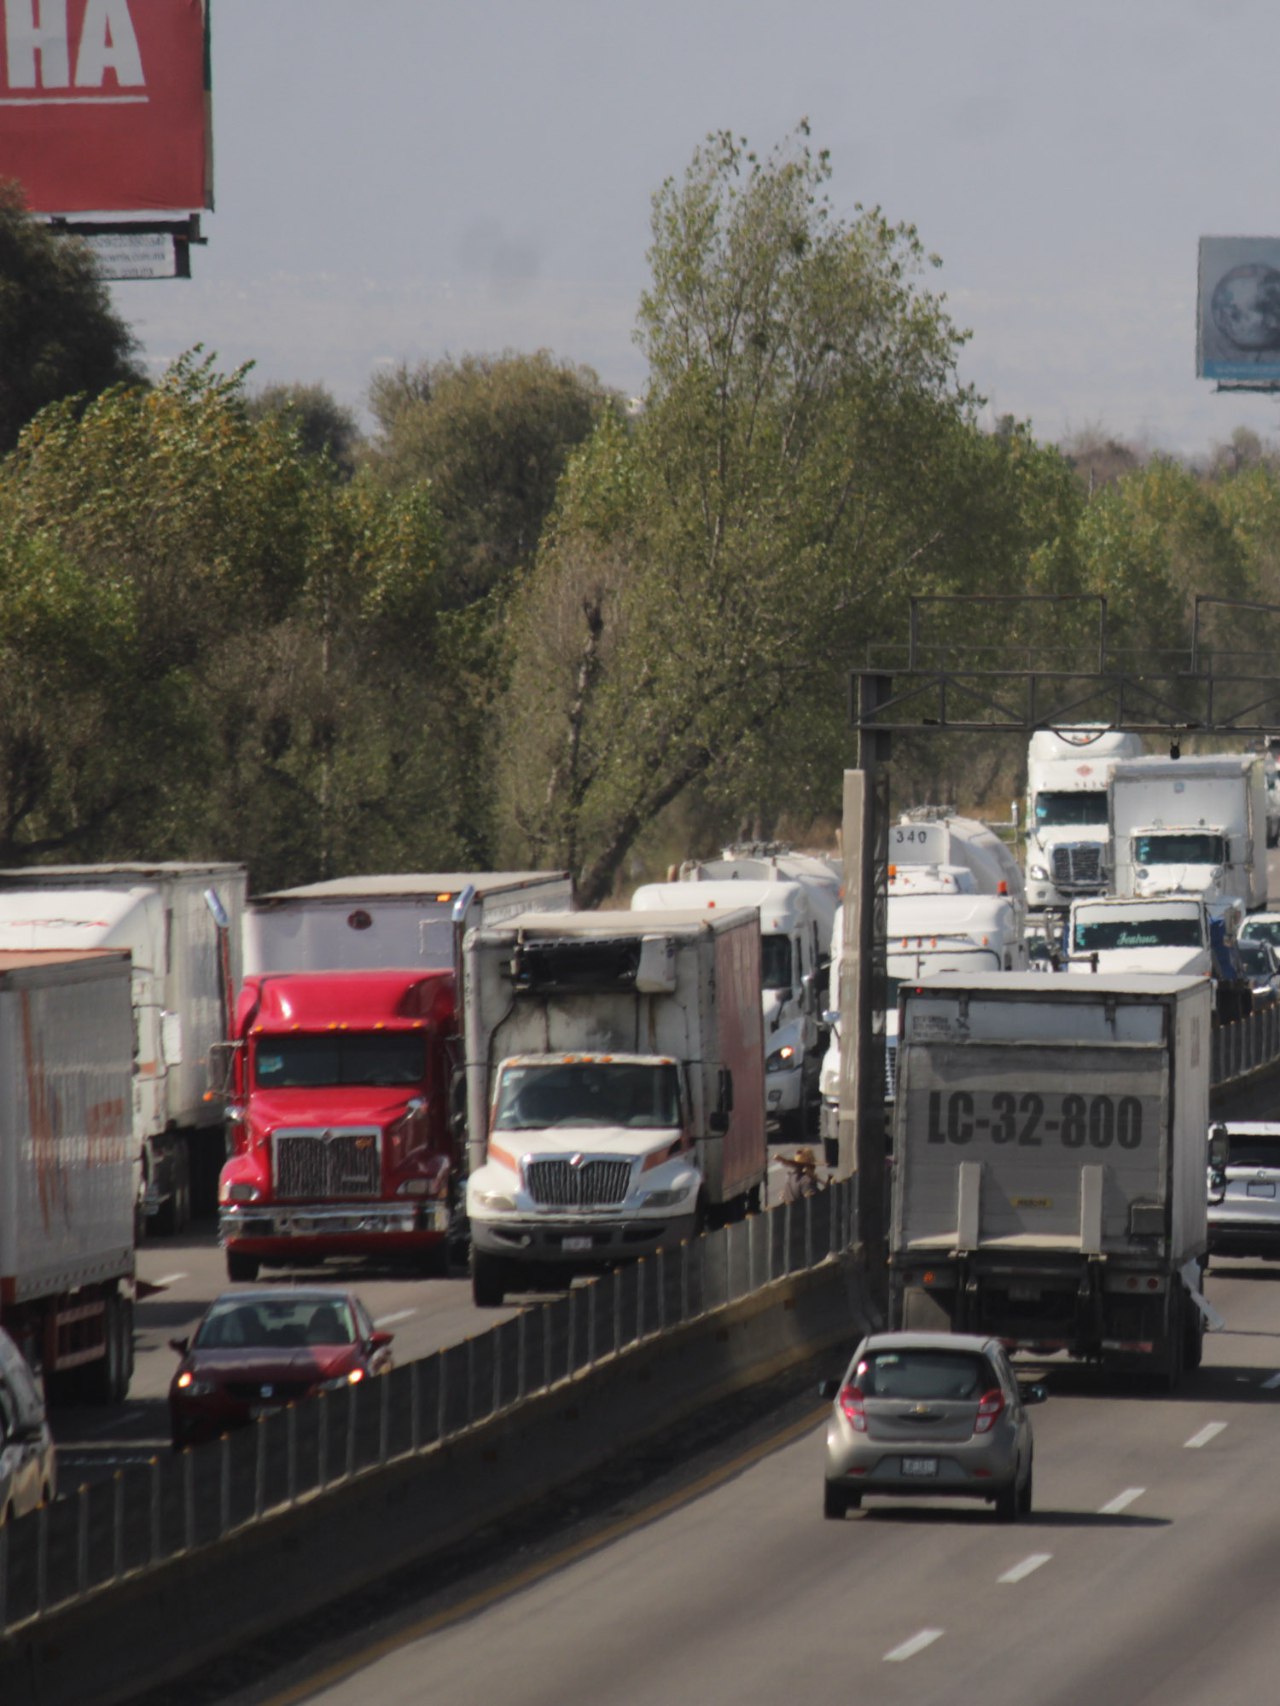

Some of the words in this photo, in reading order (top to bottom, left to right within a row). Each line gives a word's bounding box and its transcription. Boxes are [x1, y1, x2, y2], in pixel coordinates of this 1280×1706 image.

[5, 0, 146, 88] HA
[896, 830, 927, 844] 340
[927, 1090, 1144, 1150] LC-32-800
